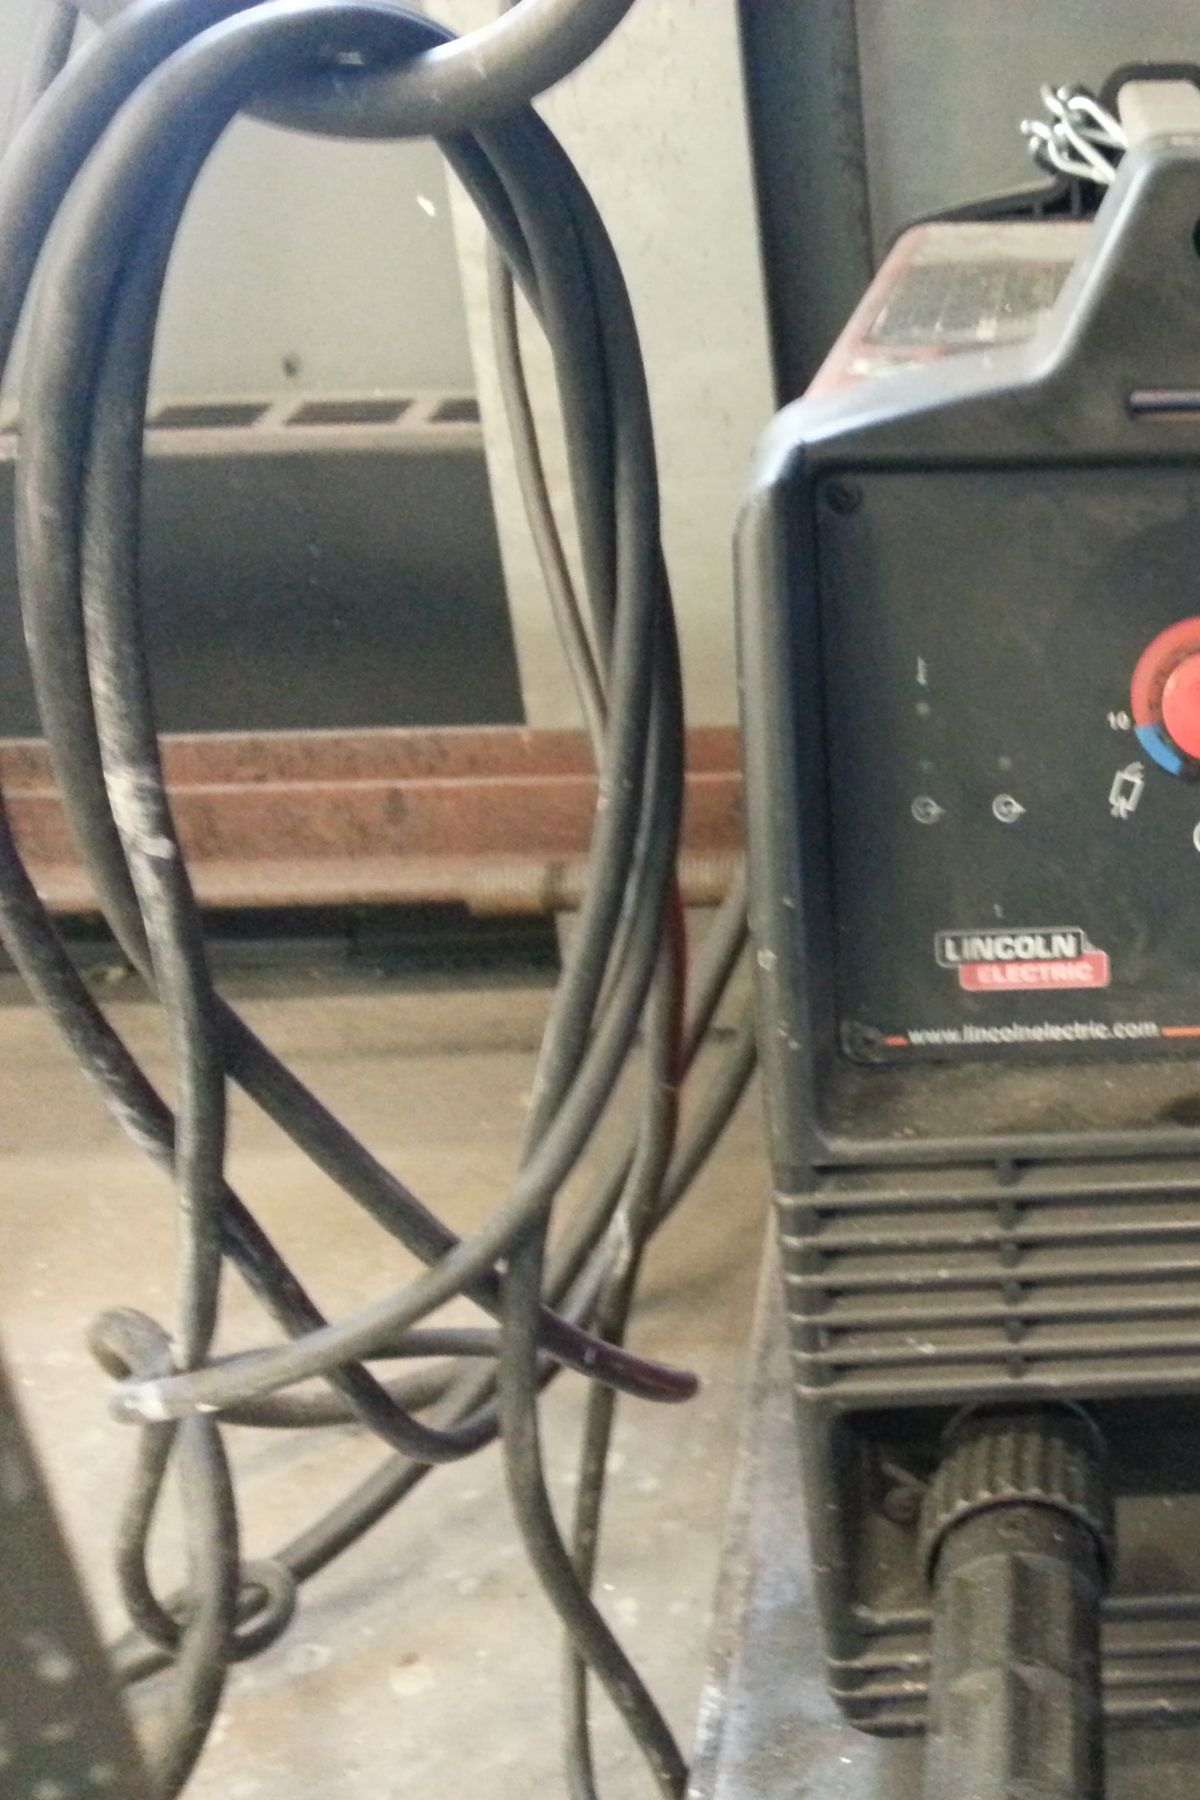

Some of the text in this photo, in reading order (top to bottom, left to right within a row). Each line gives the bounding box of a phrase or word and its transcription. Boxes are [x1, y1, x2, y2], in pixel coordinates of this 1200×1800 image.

[1107, 710, 1131, 731] 10
[944, 932, 1077, 961] LINCOLN
[976, 960, 1095, 984] ELECTRIC
[908, 1019, 1161, 1046] www.lincolnelectric.com
